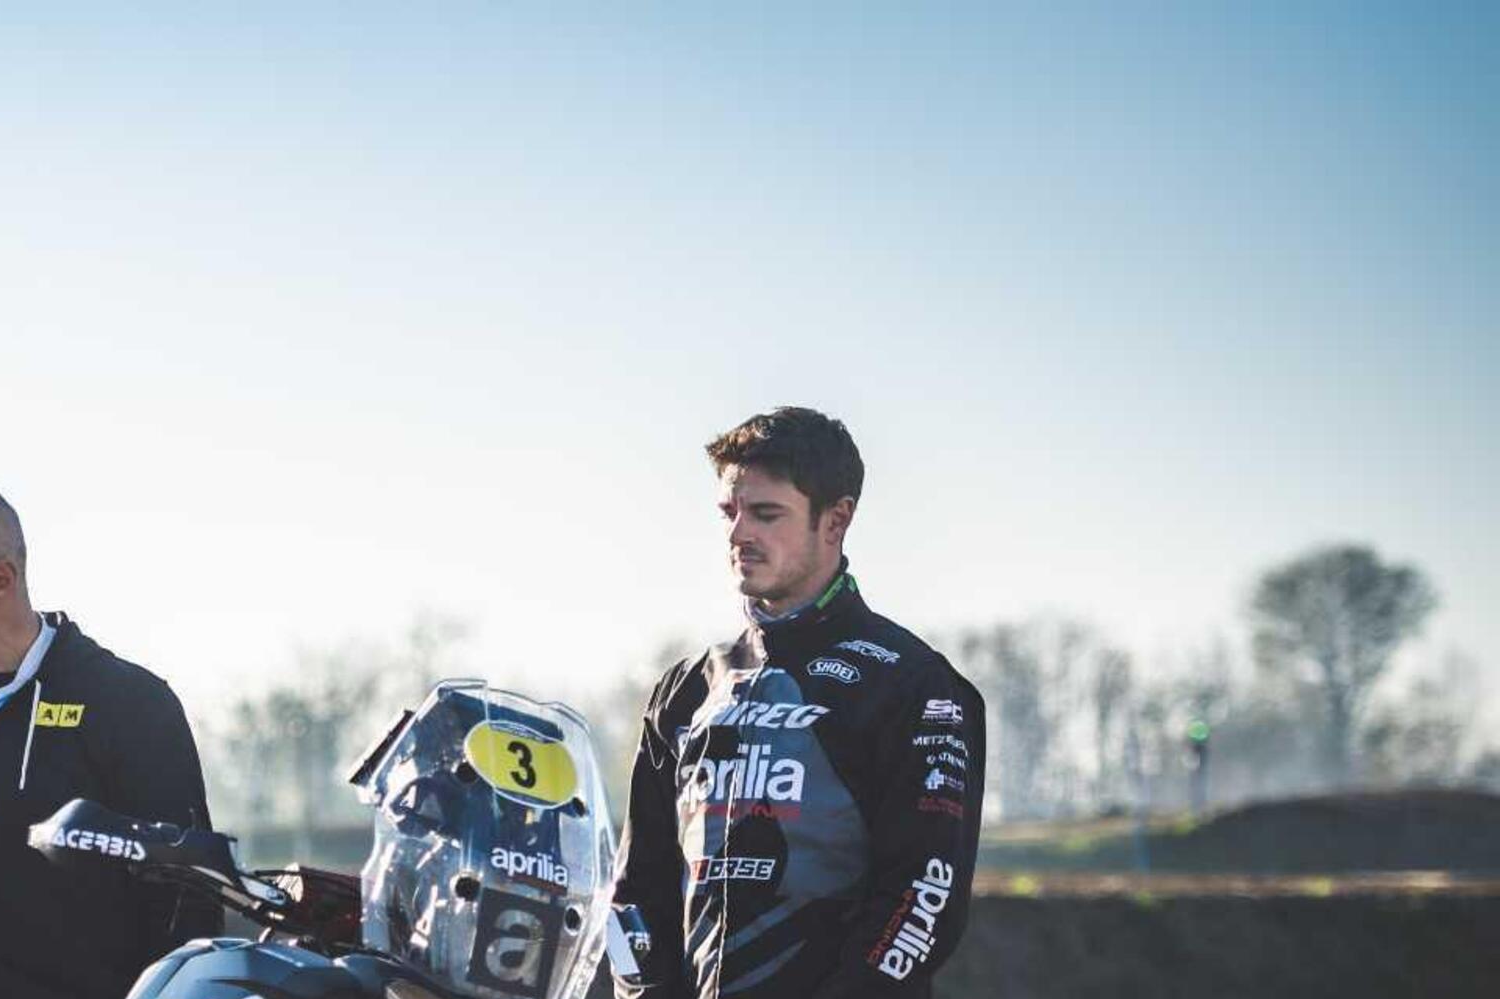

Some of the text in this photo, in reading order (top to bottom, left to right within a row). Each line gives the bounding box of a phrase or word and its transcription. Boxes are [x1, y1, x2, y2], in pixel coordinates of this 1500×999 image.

[507, 740, 536, 789] 3
[52, 827, 146, 861] ACERBIS
[490, 846, 569, 887] aprilia
[879, 857, 953, 981] aprilia
